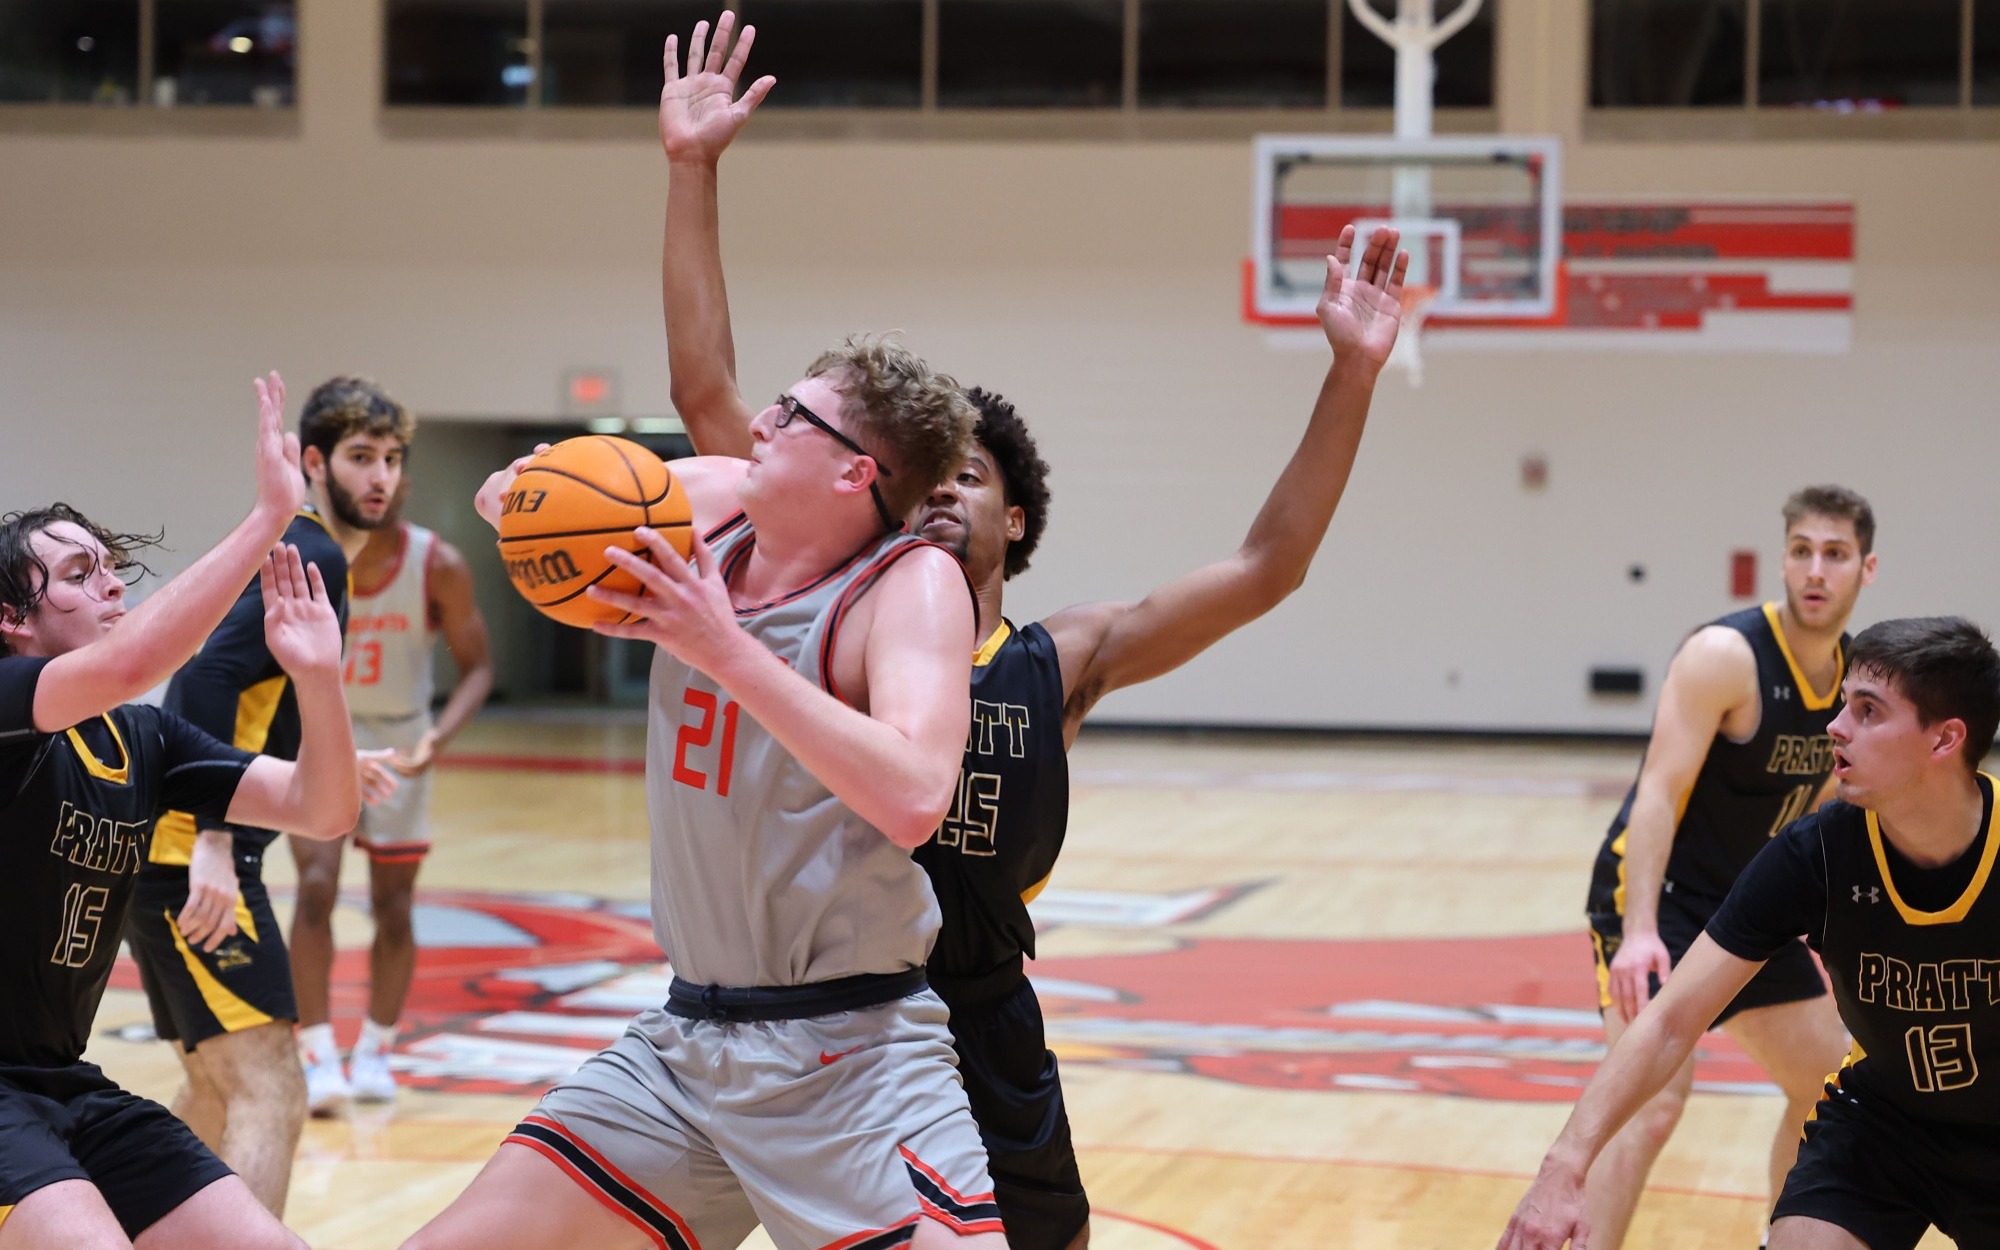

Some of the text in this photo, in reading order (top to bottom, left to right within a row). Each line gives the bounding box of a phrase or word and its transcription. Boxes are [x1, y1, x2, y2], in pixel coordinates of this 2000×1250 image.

[672, 686, 740, 798] 21
[964, 698, 1031, 759] TT
[50, 882, 110, 968] 15
[1859, 952, 2000, 1012] PRATT
[1904, 1023, 1979, 1093] 13
